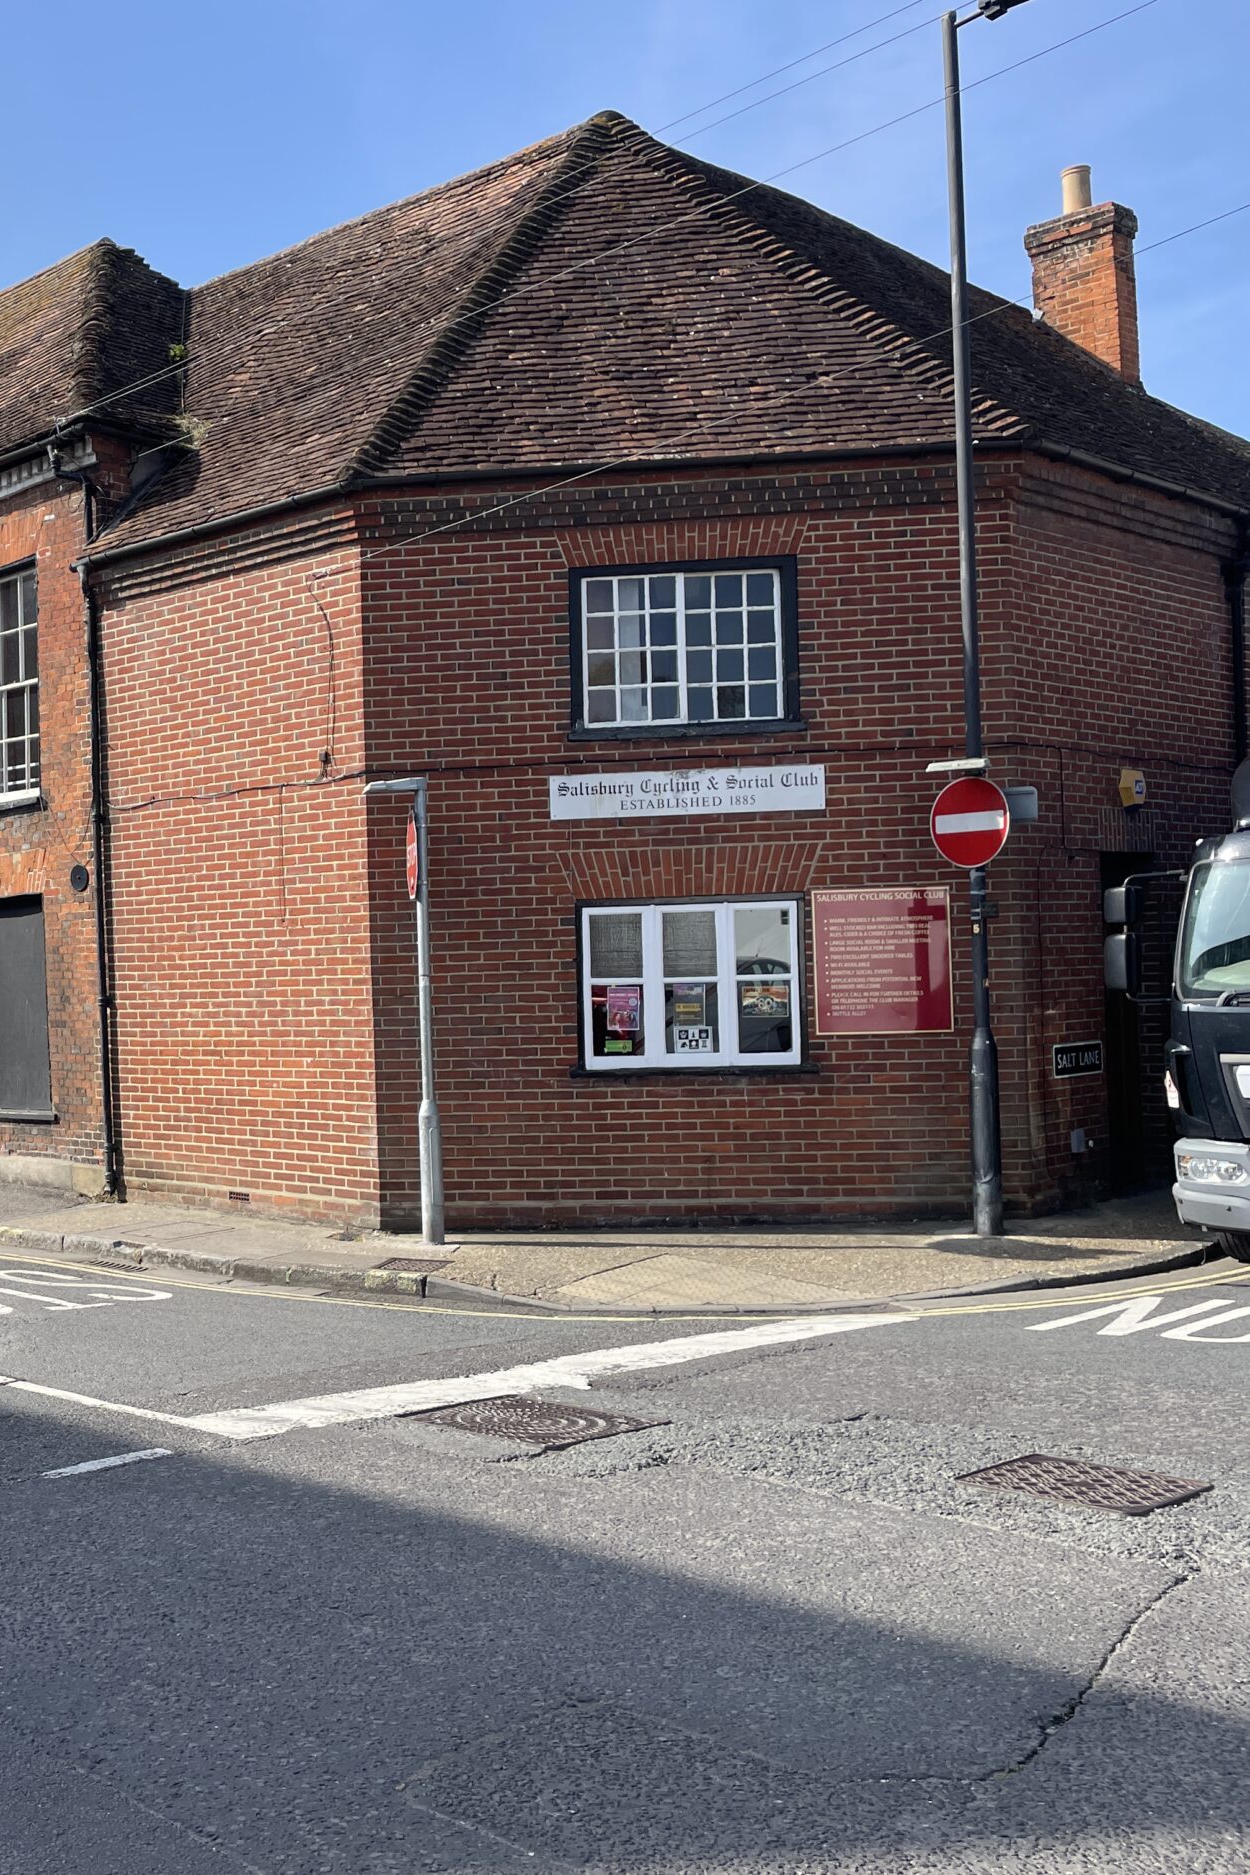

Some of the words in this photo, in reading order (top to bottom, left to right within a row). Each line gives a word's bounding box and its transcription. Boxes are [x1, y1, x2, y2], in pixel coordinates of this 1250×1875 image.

[558, 781, 634, 798] Salisbury
[640, 778, 700, 797] Cycling
[707, 776, 719, 790] &
[726, 773, 775, 789] Social
[781, 772, 819, 787] Club
[620, 796, 722, 811] ESTABLISHED
[730, 795, 756, 806] 1885
[817, 893, 858, 902] SALISBURY
[860, 892, 893, 901] CYCLING
[894, 891, 922, 900] SOCIAL
[924, 890, 945, 899] CLUB
[972, 923, 980, 934] 5
[1057, 1053, 1077, 1069] SALT
[1079, 1050, 1100, 1066] LANE
